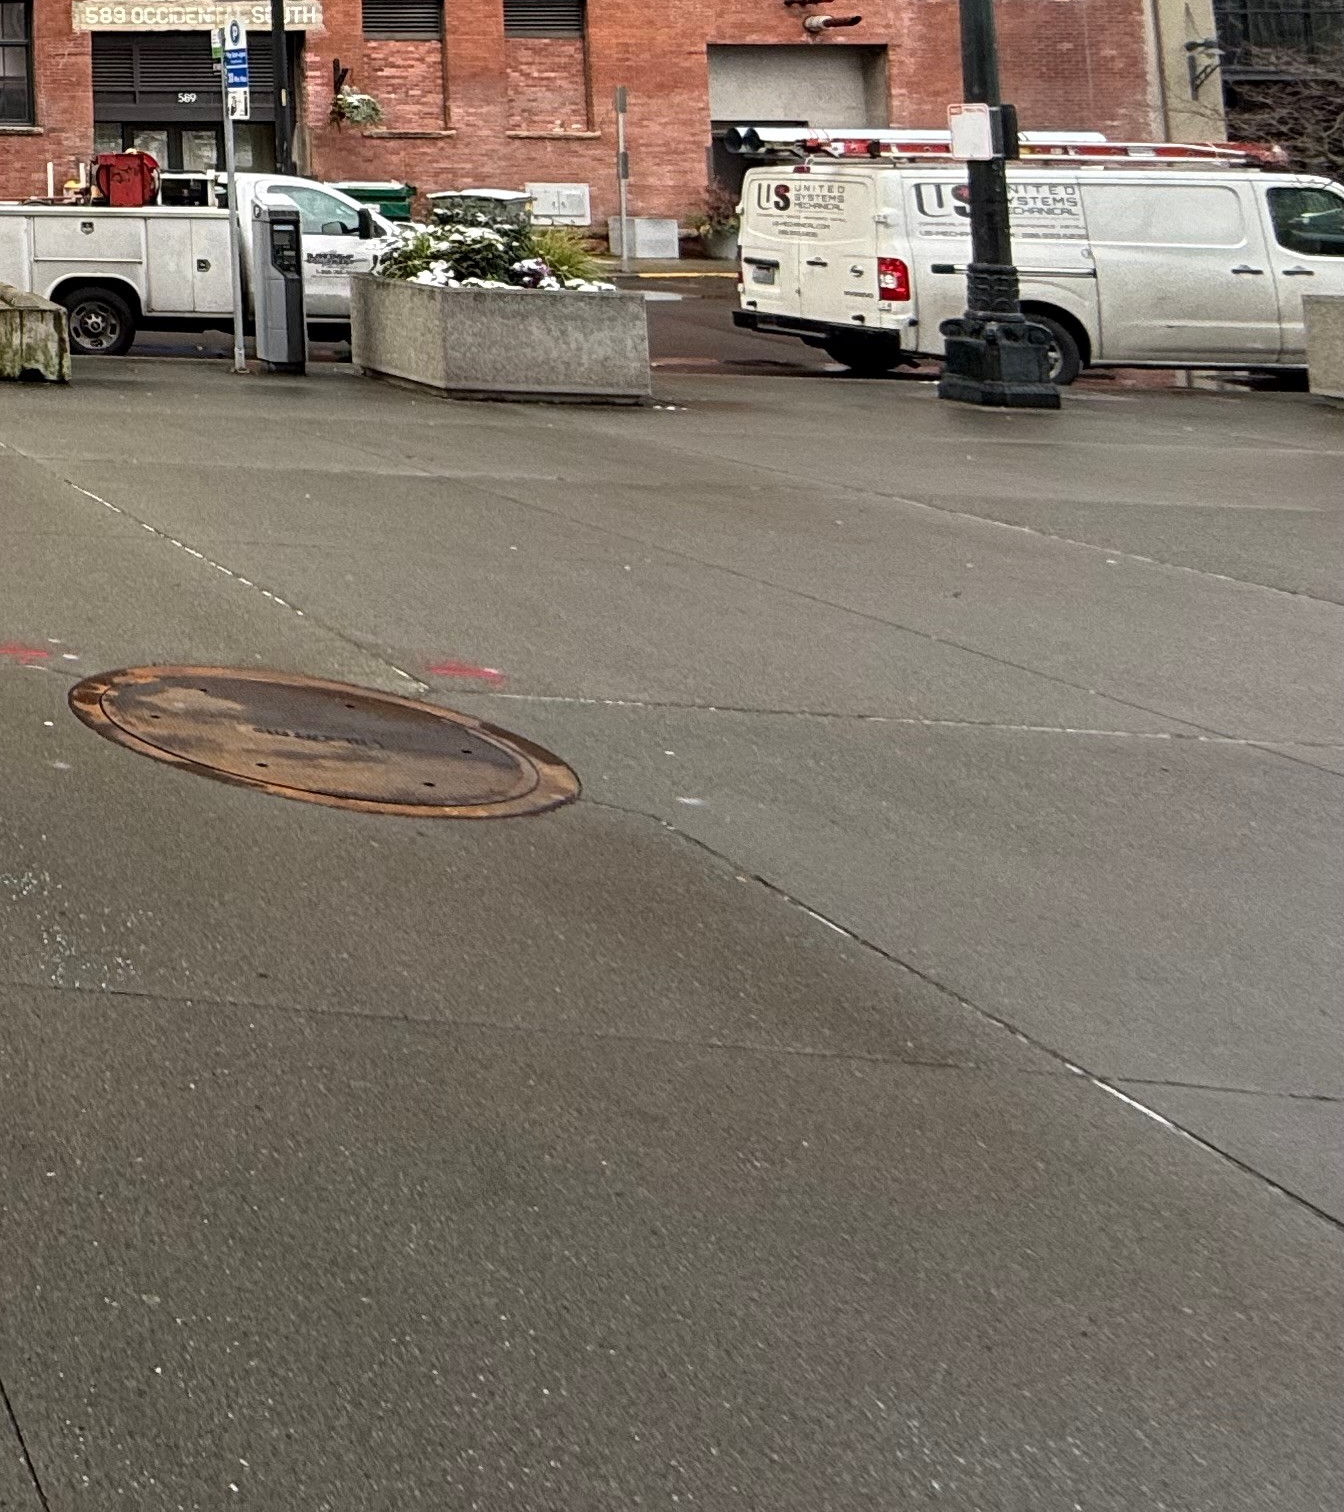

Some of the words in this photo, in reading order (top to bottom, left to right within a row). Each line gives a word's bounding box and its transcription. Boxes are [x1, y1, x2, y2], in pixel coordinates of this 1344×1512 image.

[85, 7, 126, 24] 589
[178, 92, 197, 103] 589
[794, 184, 845, 194] UNITED
[1007, 185, 1076, 196] NITED
[794, 193, 845, 204] SYSTEMS
[1007, 196, 1079, 208] YSTEMS
